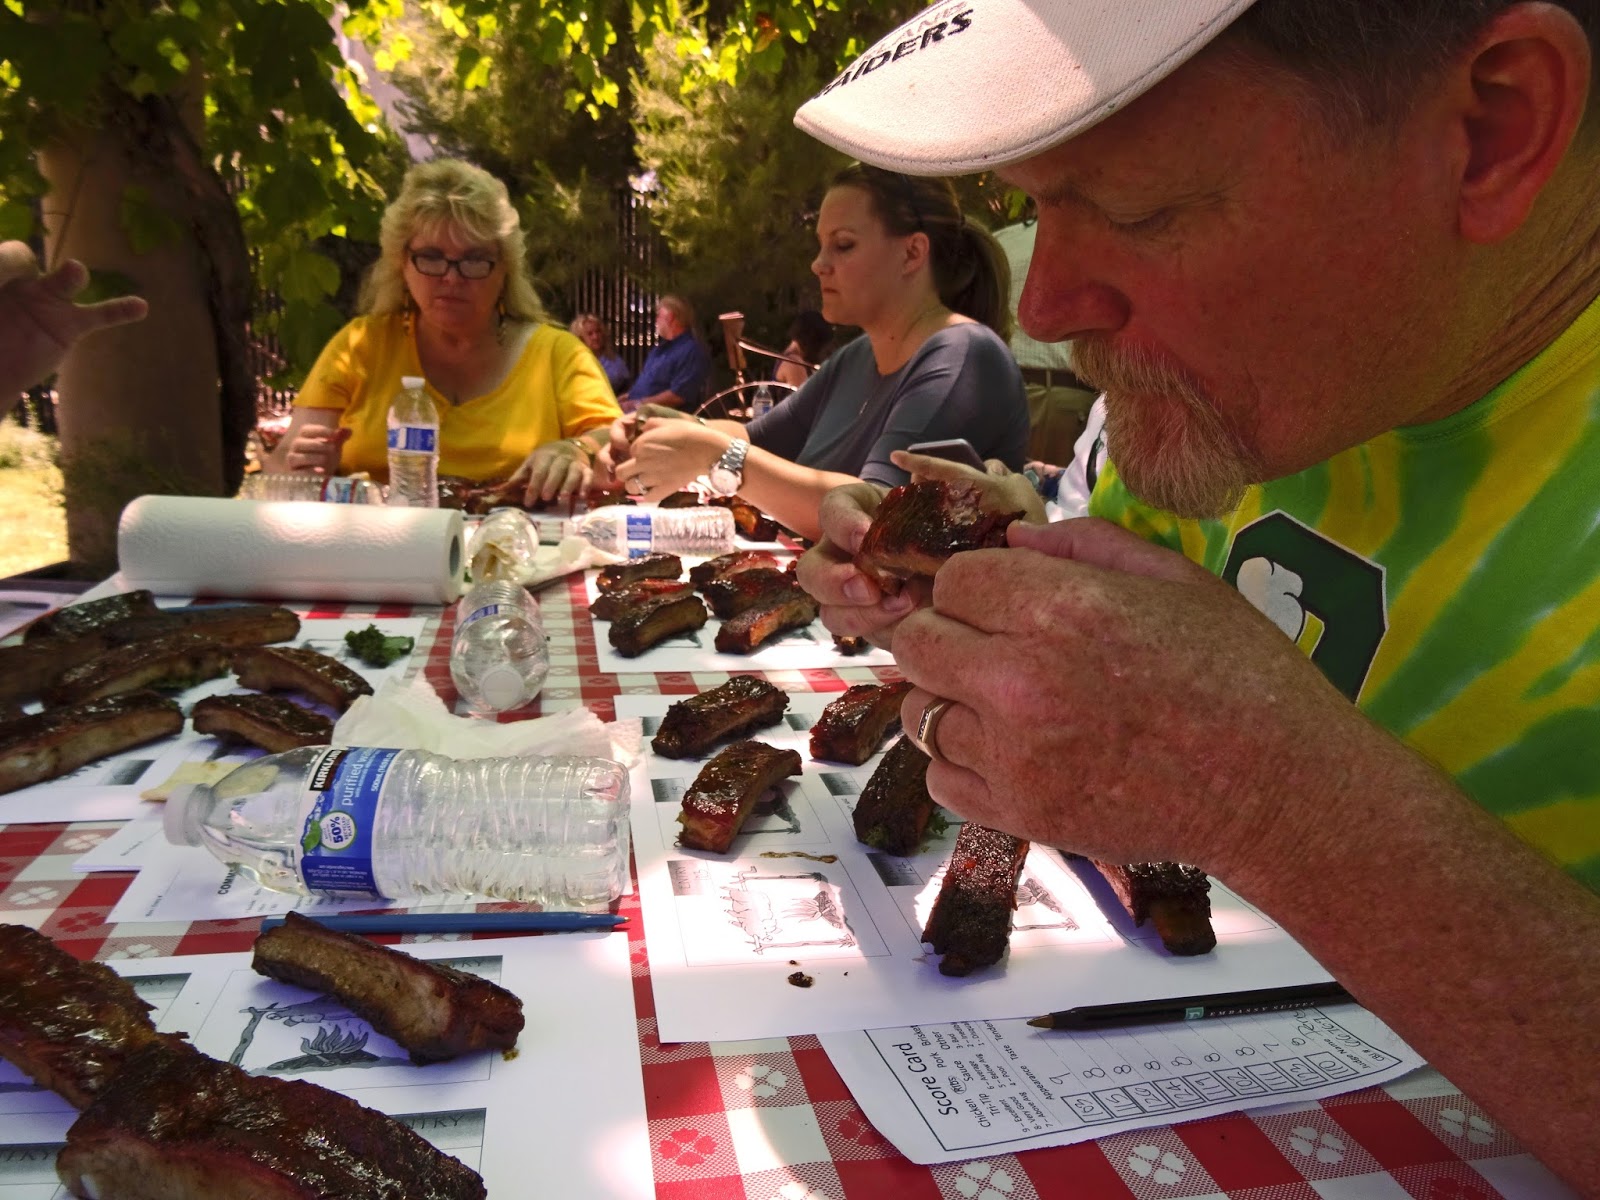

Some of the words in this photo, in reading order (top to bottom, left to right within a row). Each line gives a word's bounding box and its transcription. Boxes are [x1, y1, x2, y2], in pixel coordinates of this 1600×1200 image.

[814, 9, 974, 100] AIDERS
[313, 749, 343, 789] KIRKLAN
[341, 763, 364, 806] purified
[330, 816, 344, 844] 50%
[1209, 1006, 1268, 1017] EMBASSY
[1272, 1001, 1315, 1010] SUITES
[932, 1030, 950, 1050] Other
[948, 1032, 960, 1043] Bad
[1323, 1038, 1347, 1054] Name
[892, 1042, 928, 1073] Card
[929, 1051, 948, 1068] Pork
[976, 1052, 986, 1063] Avg
[1003, 1044, 1019, 1061] Taste
[1203, 1052, 1221, 1063] 8
[1235, 1046, 1256, 1057] 8
[969, 1059, 988, 1081] Average
[1113, 1064, 1131, 1075] 8
[1143, 1060, 1161, 1071] 8
[1170, 1056, 1193, 1067] 8
[1347, 1054, 1371, 1069] Judge
[953, 1060, 974, 1081] Sauce
[985, 1063, 999, 1079] Below
[996, 1065, 1010, 1078] Poor
[1082, 1067, 1106, 1079] 8
[948, 1075, 964, 1093] Ribs
[1020, 1065, 1054, 1100] Appearance
[1226, 1071, 1260, 1091] 102
[921, 1076, 959, 1115] Score
[1008, 1096, 1024, 1110] Good
[1019, 1091, 1030, 1101] Avg
[965, 1098, 991, 1128] Chicken
[978, 1093, 1001, 1116] Tri-Tip
[999, 1098, 1022, 1122] Excellent
[1028, 1102, 1045, 1118] Above
[1074, 1098, 1103, 1117] 103
[1022, 1110, 1035, 1123] Very
